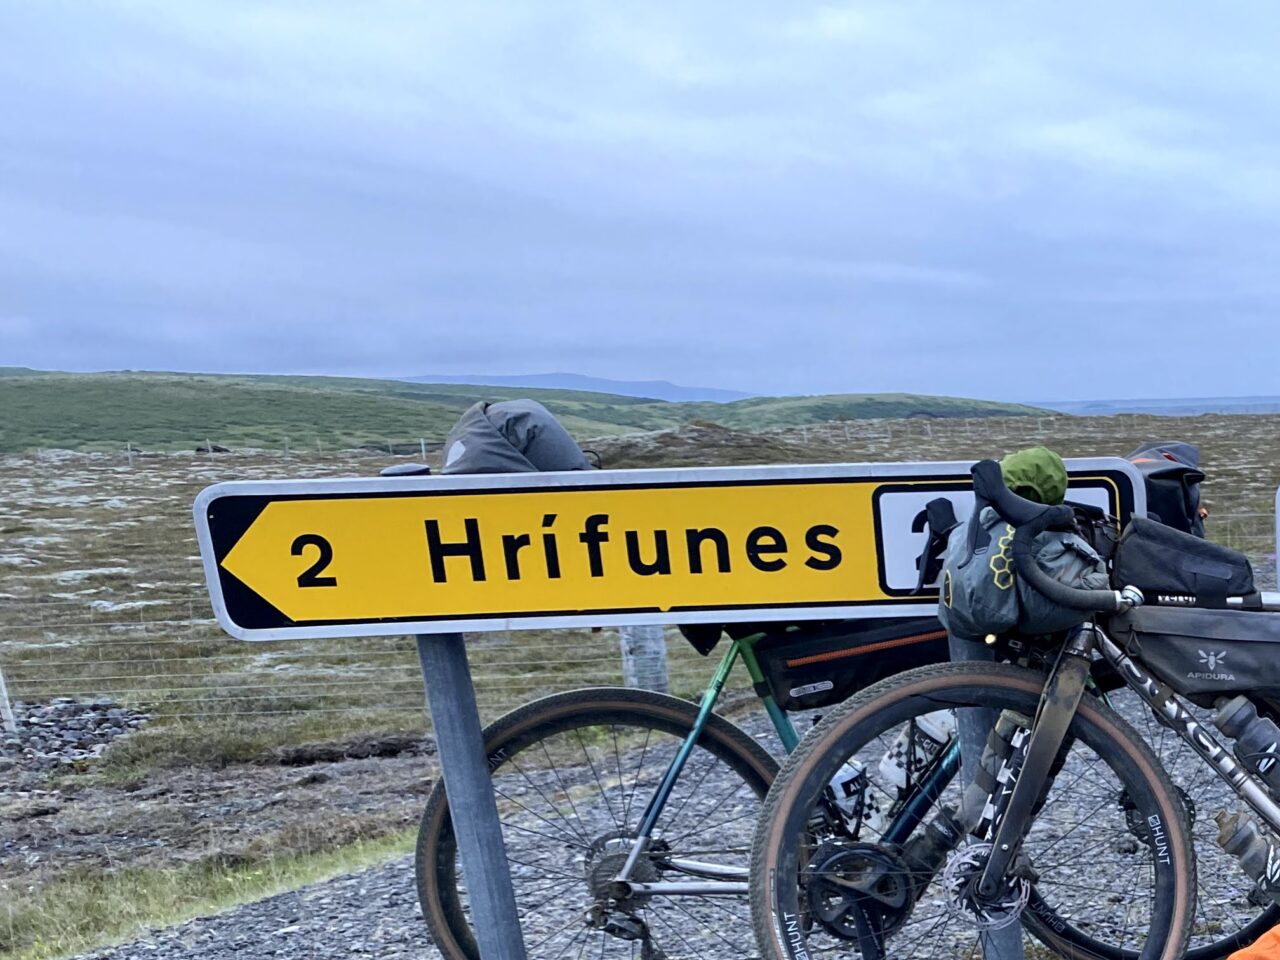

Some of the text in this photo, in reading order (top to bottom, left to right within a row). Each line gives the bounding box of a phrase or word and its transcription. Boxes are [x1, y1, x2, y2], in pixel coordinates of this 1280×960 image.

[290, 533, 338, 588] 2
[424, 513, 843, 584] Hrífunes
[1187, 671, 1236, 681] APIDURA
[1152, 825, 1171, 865] HUNT
[783, 911, 805, 954] HUNT
